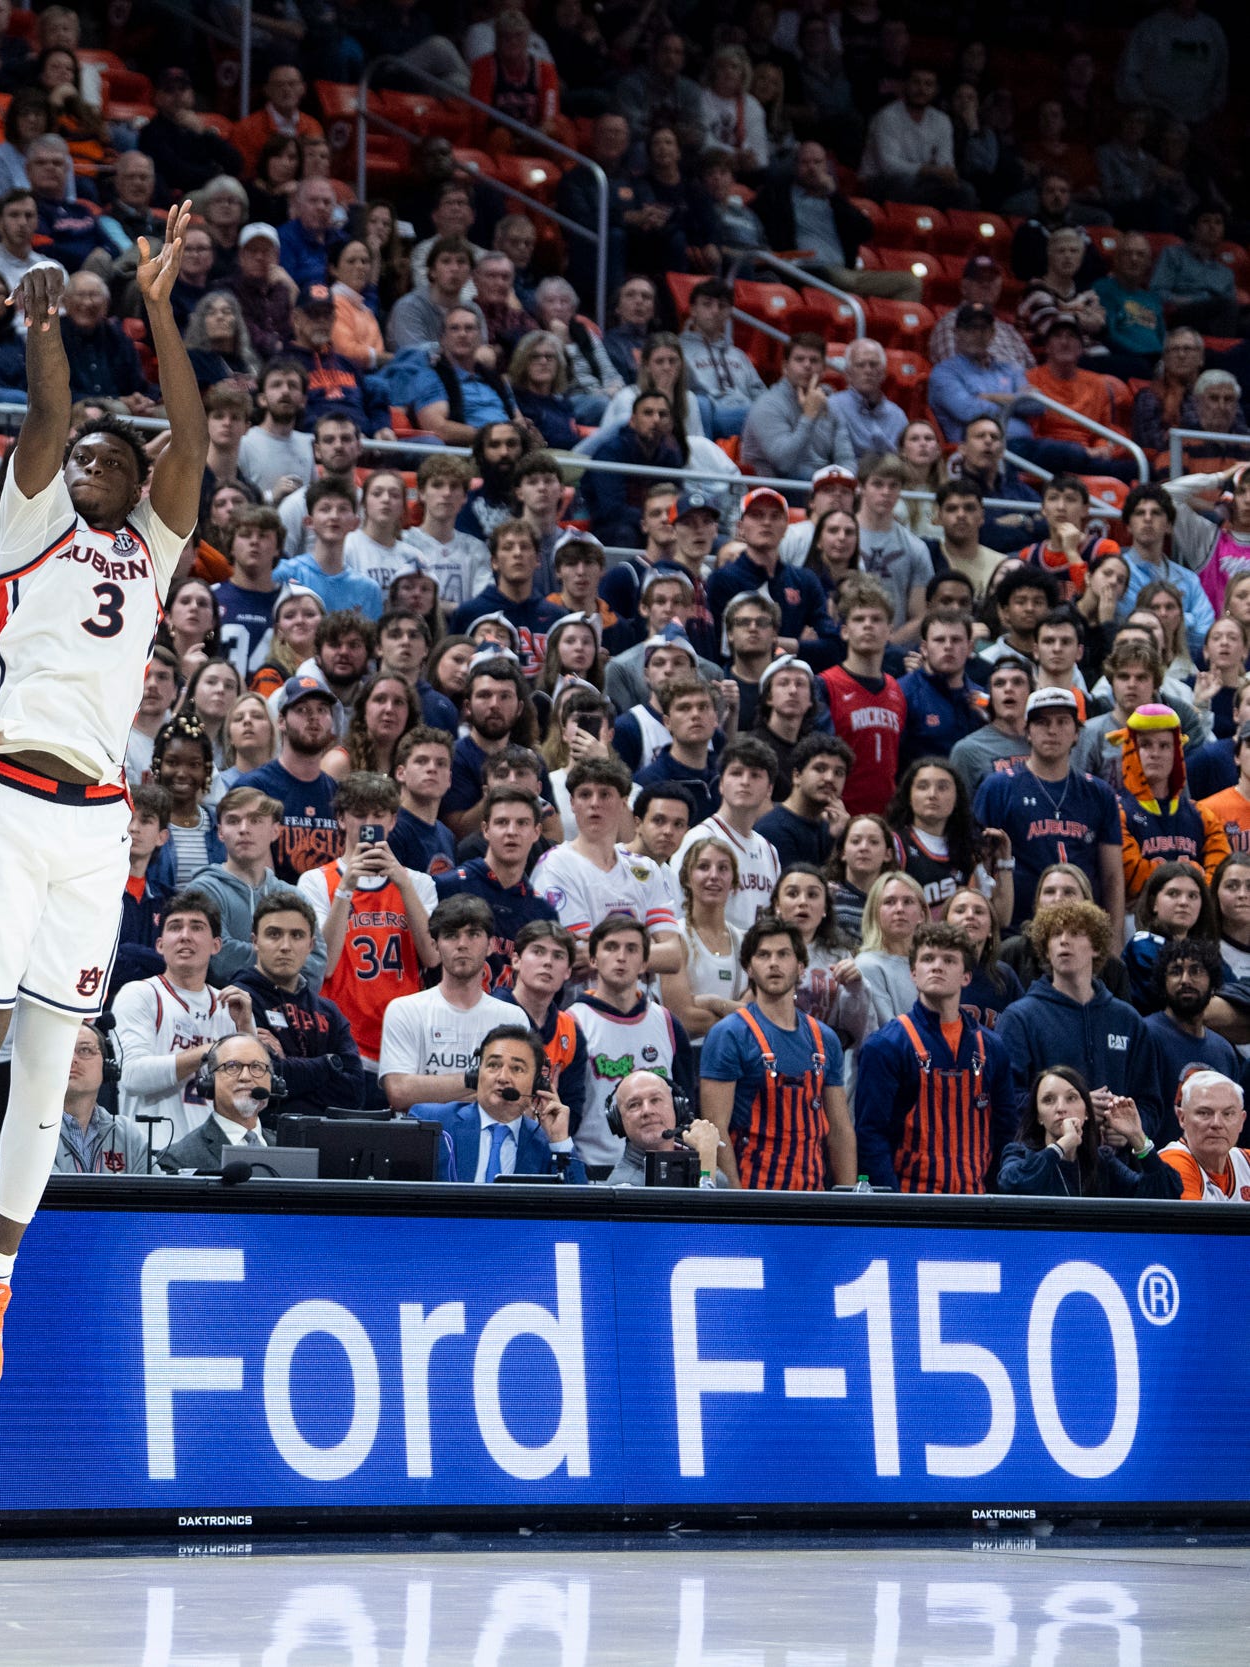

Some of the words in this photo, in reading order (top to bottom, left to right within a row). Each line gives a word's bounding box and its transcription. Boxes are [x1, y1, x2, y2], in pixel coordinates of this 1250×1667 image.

[80, 581, 125, 639] 3
[851, 706, 900, 732] ROCKETS
[874, 732, 882, 763] 1
[284, 815, 312, 828] FEAR
[315, 817, 338, 830] THE
[1141, 835, 1198, 857] AUBURN
[352, 933, 404, 981] 34
[1107, 1033, 1129, 1051] CAT
[141, 1241, 592, 1482] Ford
[178, 1515, 253, 1526] DAKTRONICS
[972, 1509, 1037, 1519] DAKTRONICS
